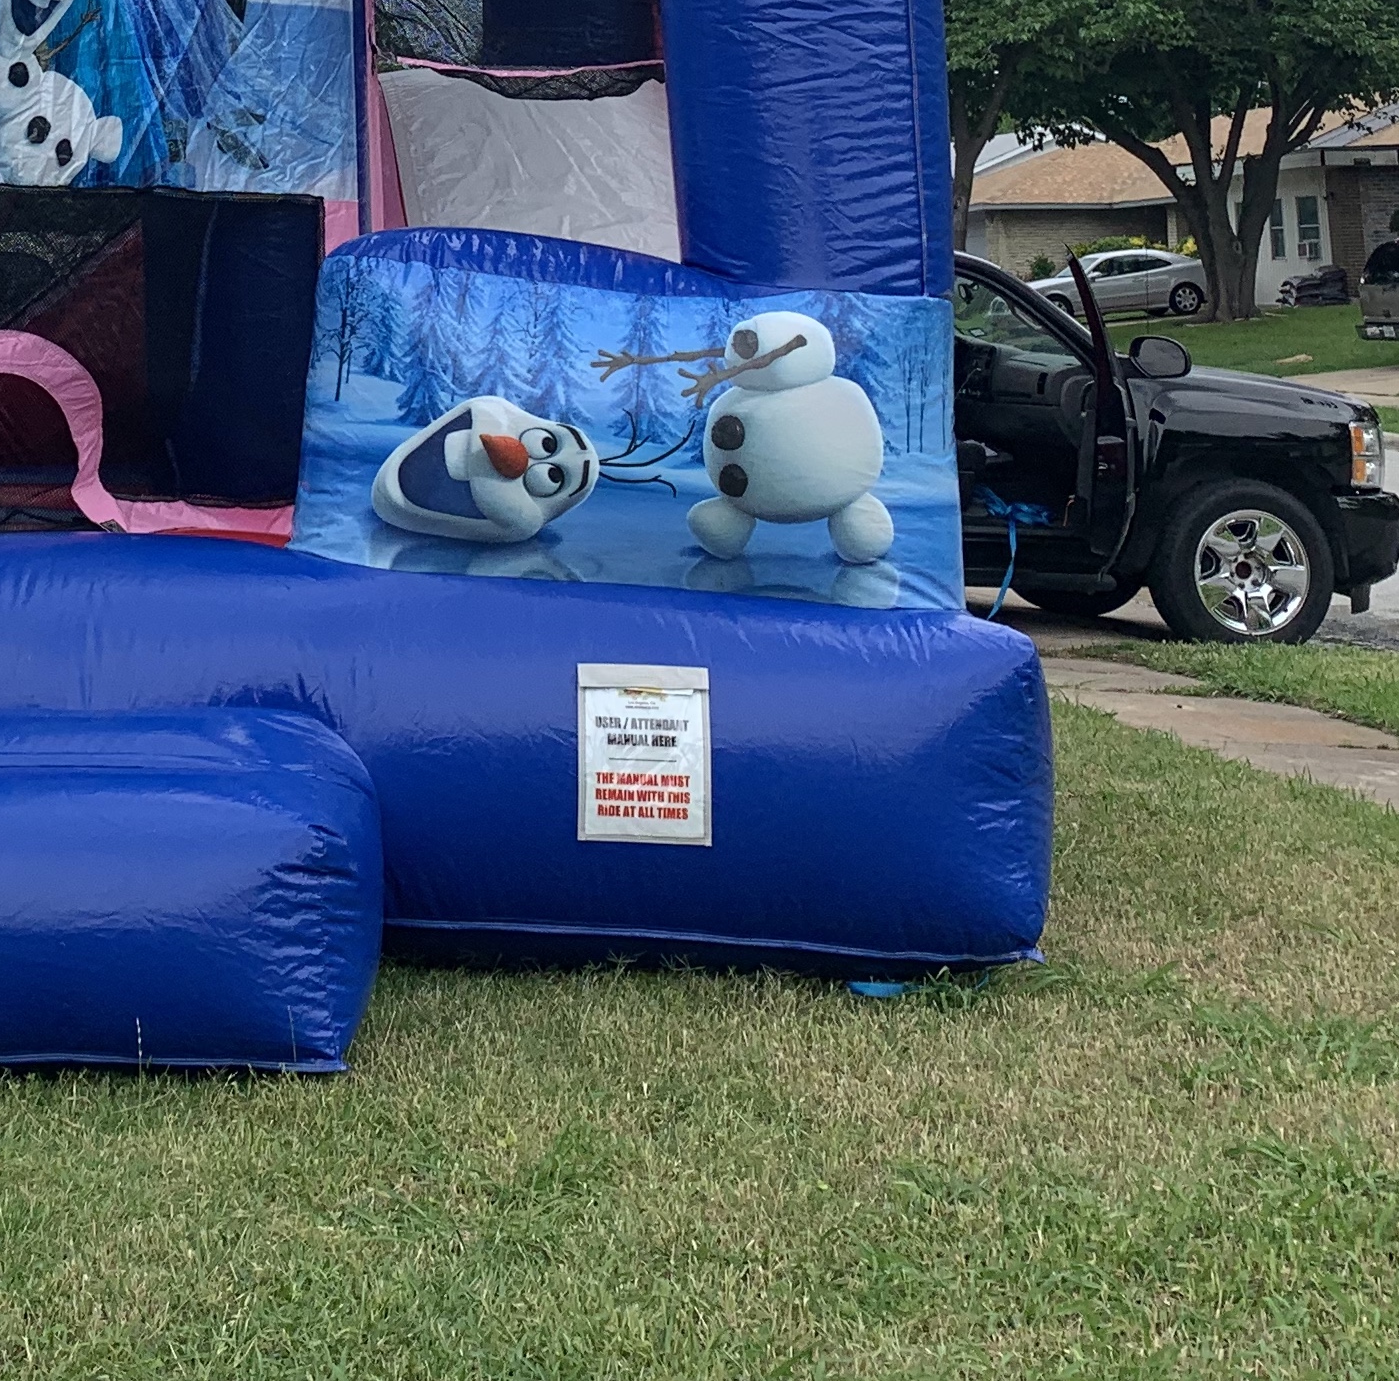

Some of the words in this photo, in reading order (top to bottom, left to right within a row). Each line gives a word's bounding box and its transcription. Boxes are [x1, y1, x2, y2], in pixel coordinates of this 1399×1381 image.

[595, 716, 621, 729] USER
[630, 718, 689, 732] ATTENDANT
[607, 734, 649, 747] MANUAL
[652, 735, 677, 748] HERE
[596, 772, 614, 784] THE
[617, 773, 658, 786] MANUAL
[660, 775, 691, 788] MUST
[595, 788, 634, 801] REMAIN
[636, 790, 664, 803] WITH
[668, 791, 690, 804] THIS
[597, 804, 620, 817] RIDE
[623, 805, 636, 818] AT
[638, 806, 655, 818] ALL
[657, 807, 688, 820] TIMES
